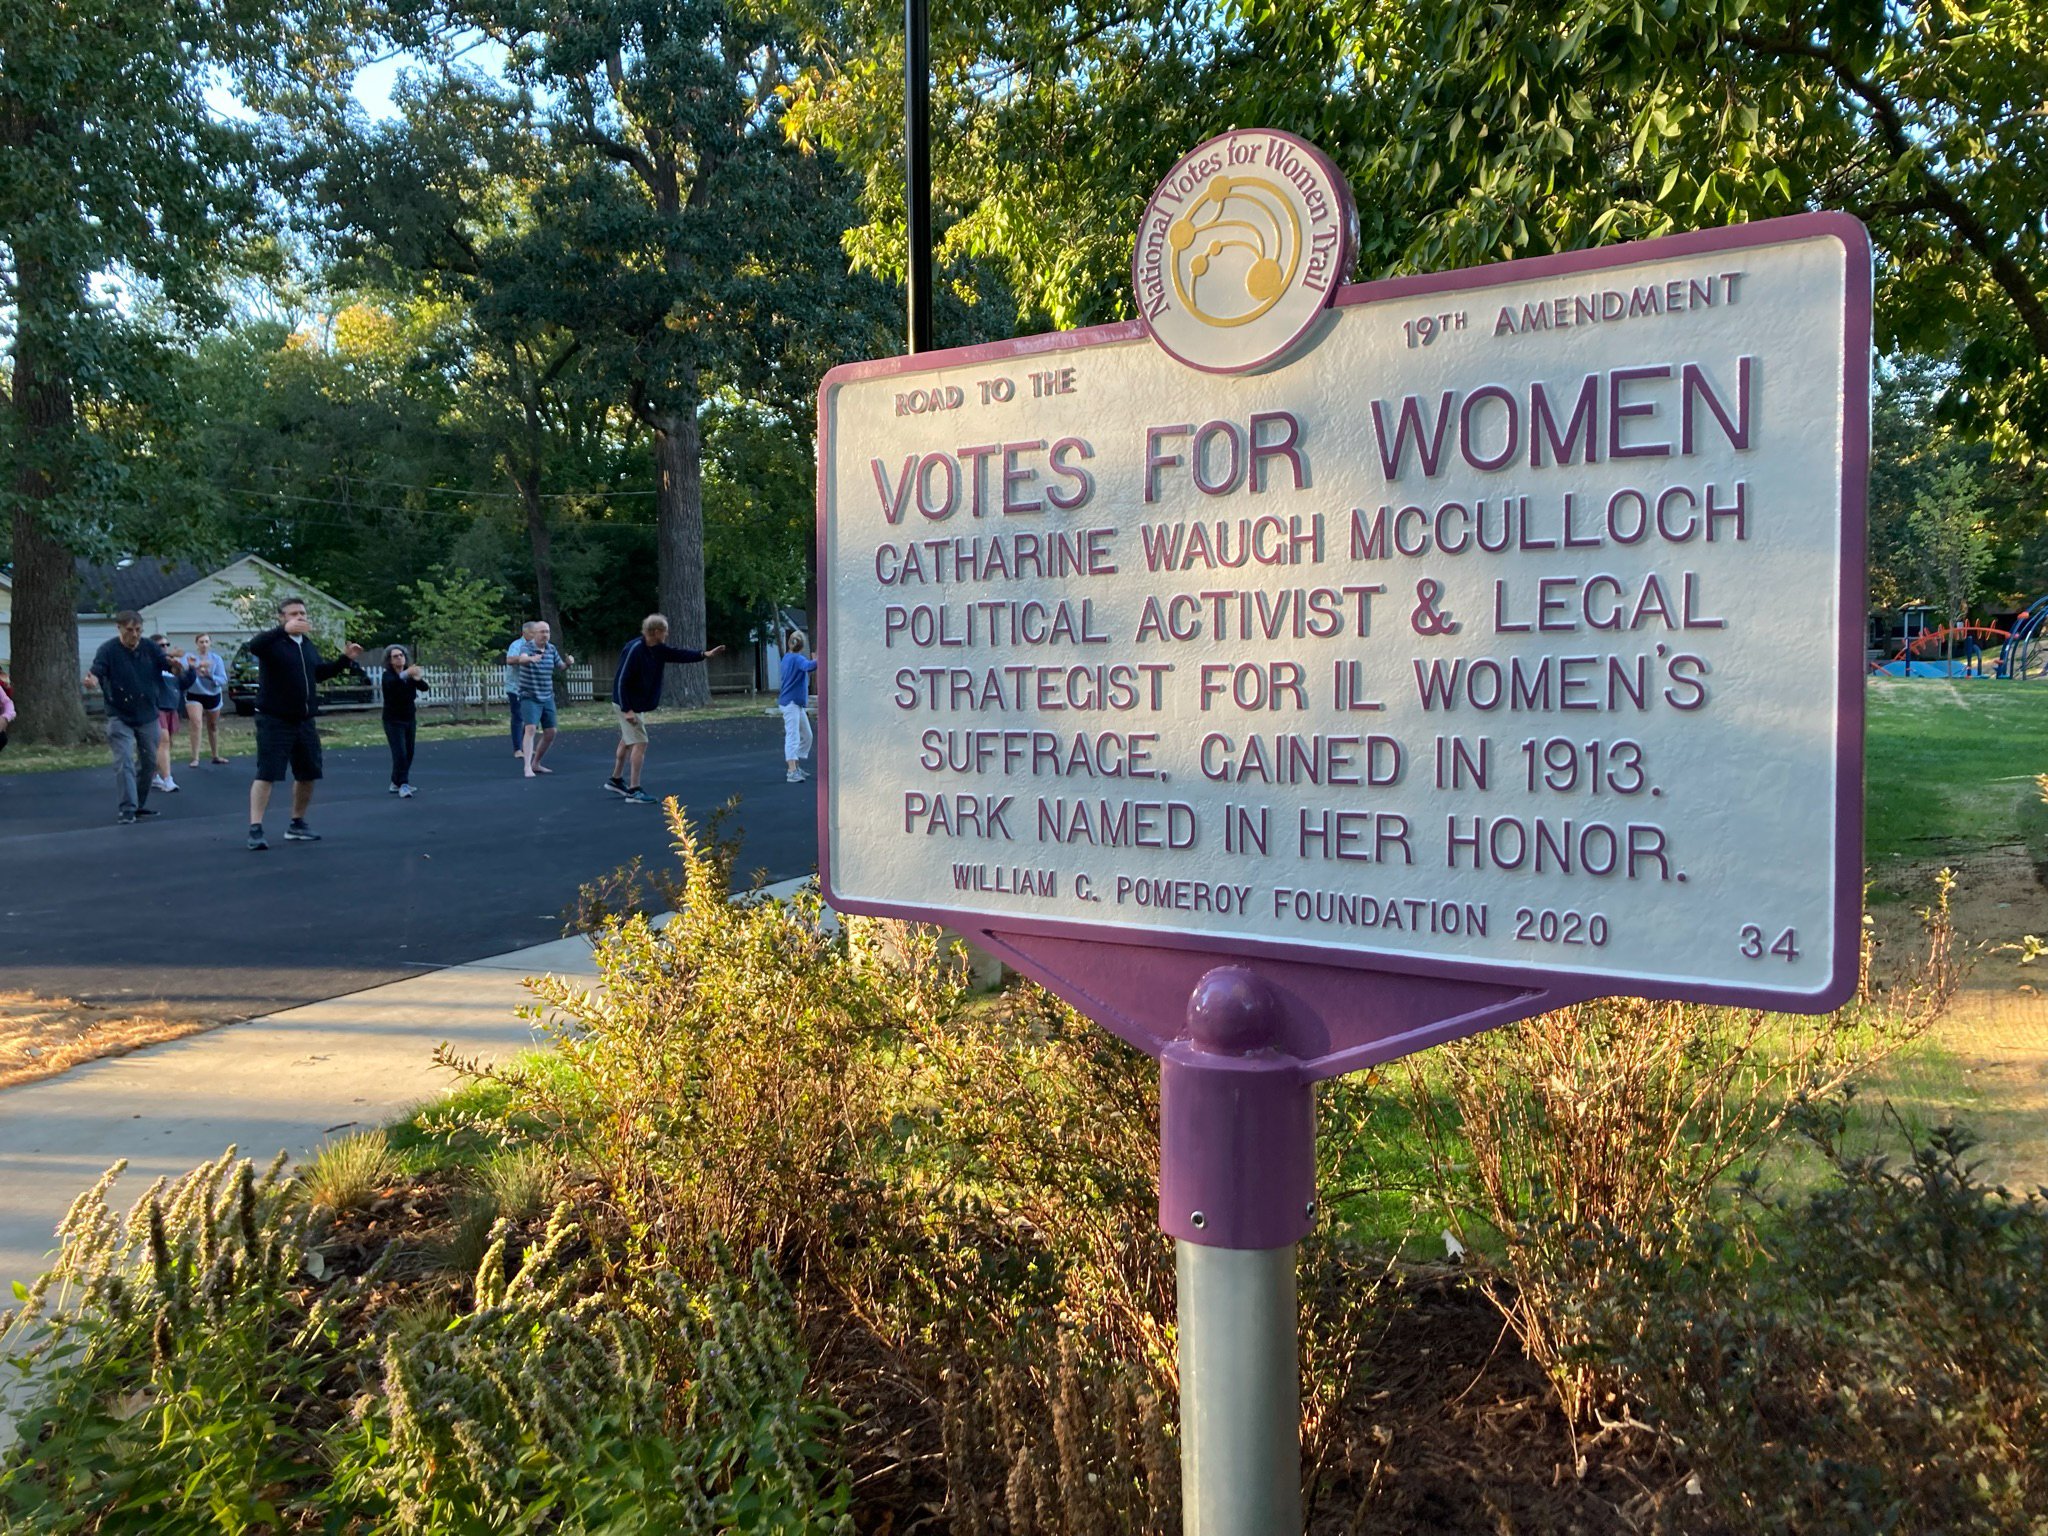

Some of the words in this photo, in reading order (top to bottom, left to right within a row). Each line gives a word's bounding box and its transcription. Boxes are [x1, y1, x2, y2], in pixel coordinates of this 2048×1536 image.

[1138, 205, 1174, 322] National
[1161, 151, 1222, 203] Votes
[1226, 136, 1262, 166] for
[1264, 137, 1328, 224] Women
[1302, 224, 1338, 292] Trail
[894, 385, 964, 416] ROAD
[977, 376, 1015, 404] TO
[1028, 367, 1077, 398] THE
[1493, 271, 1748, 337] AMENDMENT
[870, 436, 1095, 526] VOTES
[1144, 410, 1309, 502] FOR
[1370, 355, 1753, 482] WOMEN
[874, 528, 1118, 586] CATHARINE
[1141, 512, 1324, 572] WAUGH
[1350, 481, 1748, 560] MCCULLOCH
[884, 597, 1109, 648] POLITICAL
[1134, 583, 1386, 643] ACTIVIST
[1410, 576, 1458, 636] &
[1494, 571, 1727, 633] LEGAL
[894, 663, 1174, 712] STRATEGIST
[1201, 660, 1305, 712] FOR
[1333, 659, 1384, 712] IL
[1411, 643, 1707, 712] WOMEN'S
[1200, 732, 1402, 788] GAINED
[1435, 735, 1488, 790] IN
[1520, 736, 1662, 798] 1913.
[904, 790, 1015, 840] PARK
[1037, 797, 1197, 849] NAMED
[1224, 802, 1269, 856] IN
[1299, 806, 1413, 866] HER
[1447, 814, 1689, 883] HONOR.
[951, 862, 1056, 897] WILLIAM
[1116, 876, 1250, 915] POMEROY
[1274, 887, 1488, 937] FOUNDATION
[1513, 907, 1609, 946] 2020
[1739, 924, 1800, 963] 34
